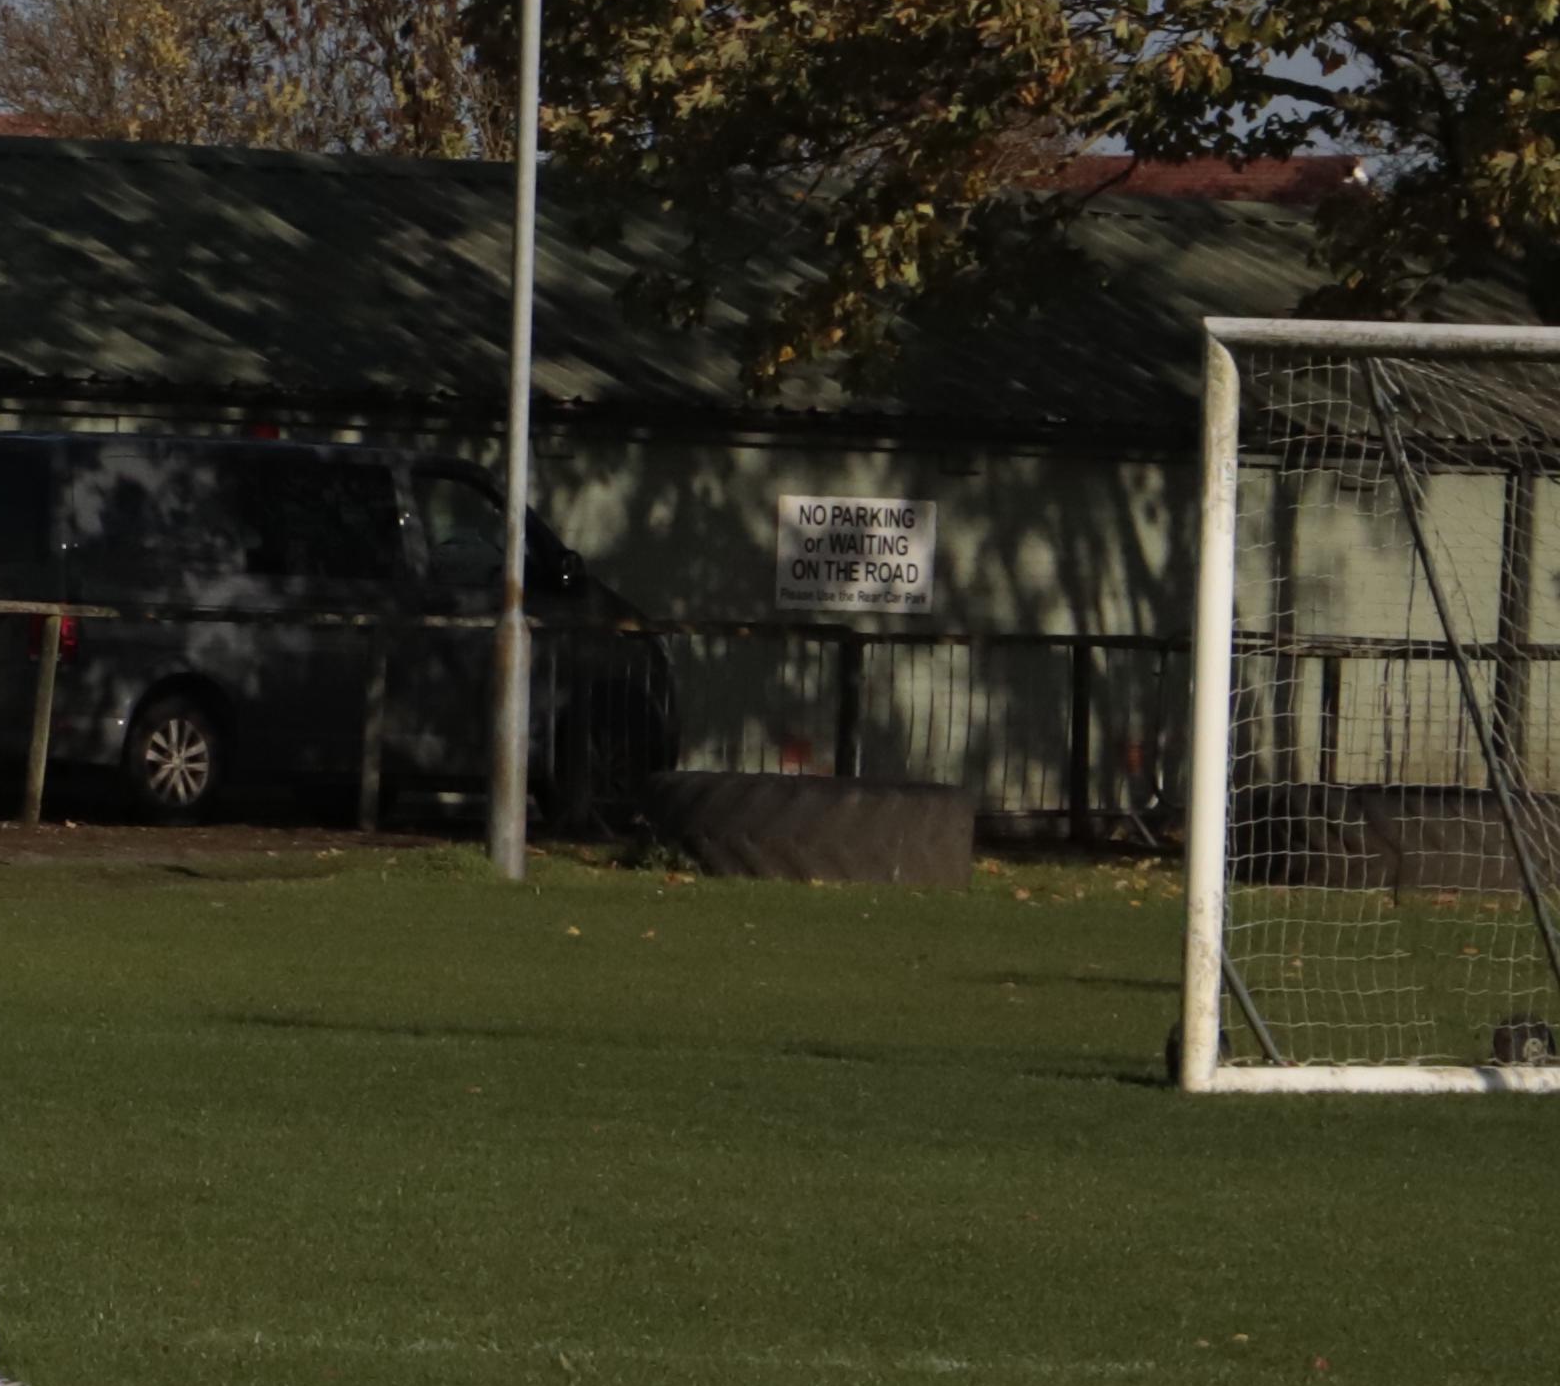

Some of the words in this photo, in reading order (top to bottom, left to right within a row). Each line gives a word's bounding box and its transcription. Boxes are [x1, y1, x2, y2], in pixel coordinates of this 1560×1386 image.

[799, 505, 826, 525] NO
[831, 506, 915, 529] PARKING
[804, 537, 824, 553] or
[829, 534, 908, 556] WAITING
[792, 559, 819, 580] ON
[825, 560, 860, 582] THE
[865, 562, 918, 583] ROAD
[838, 589, 854, 602] the
[885, 591, 902, 603] Car
